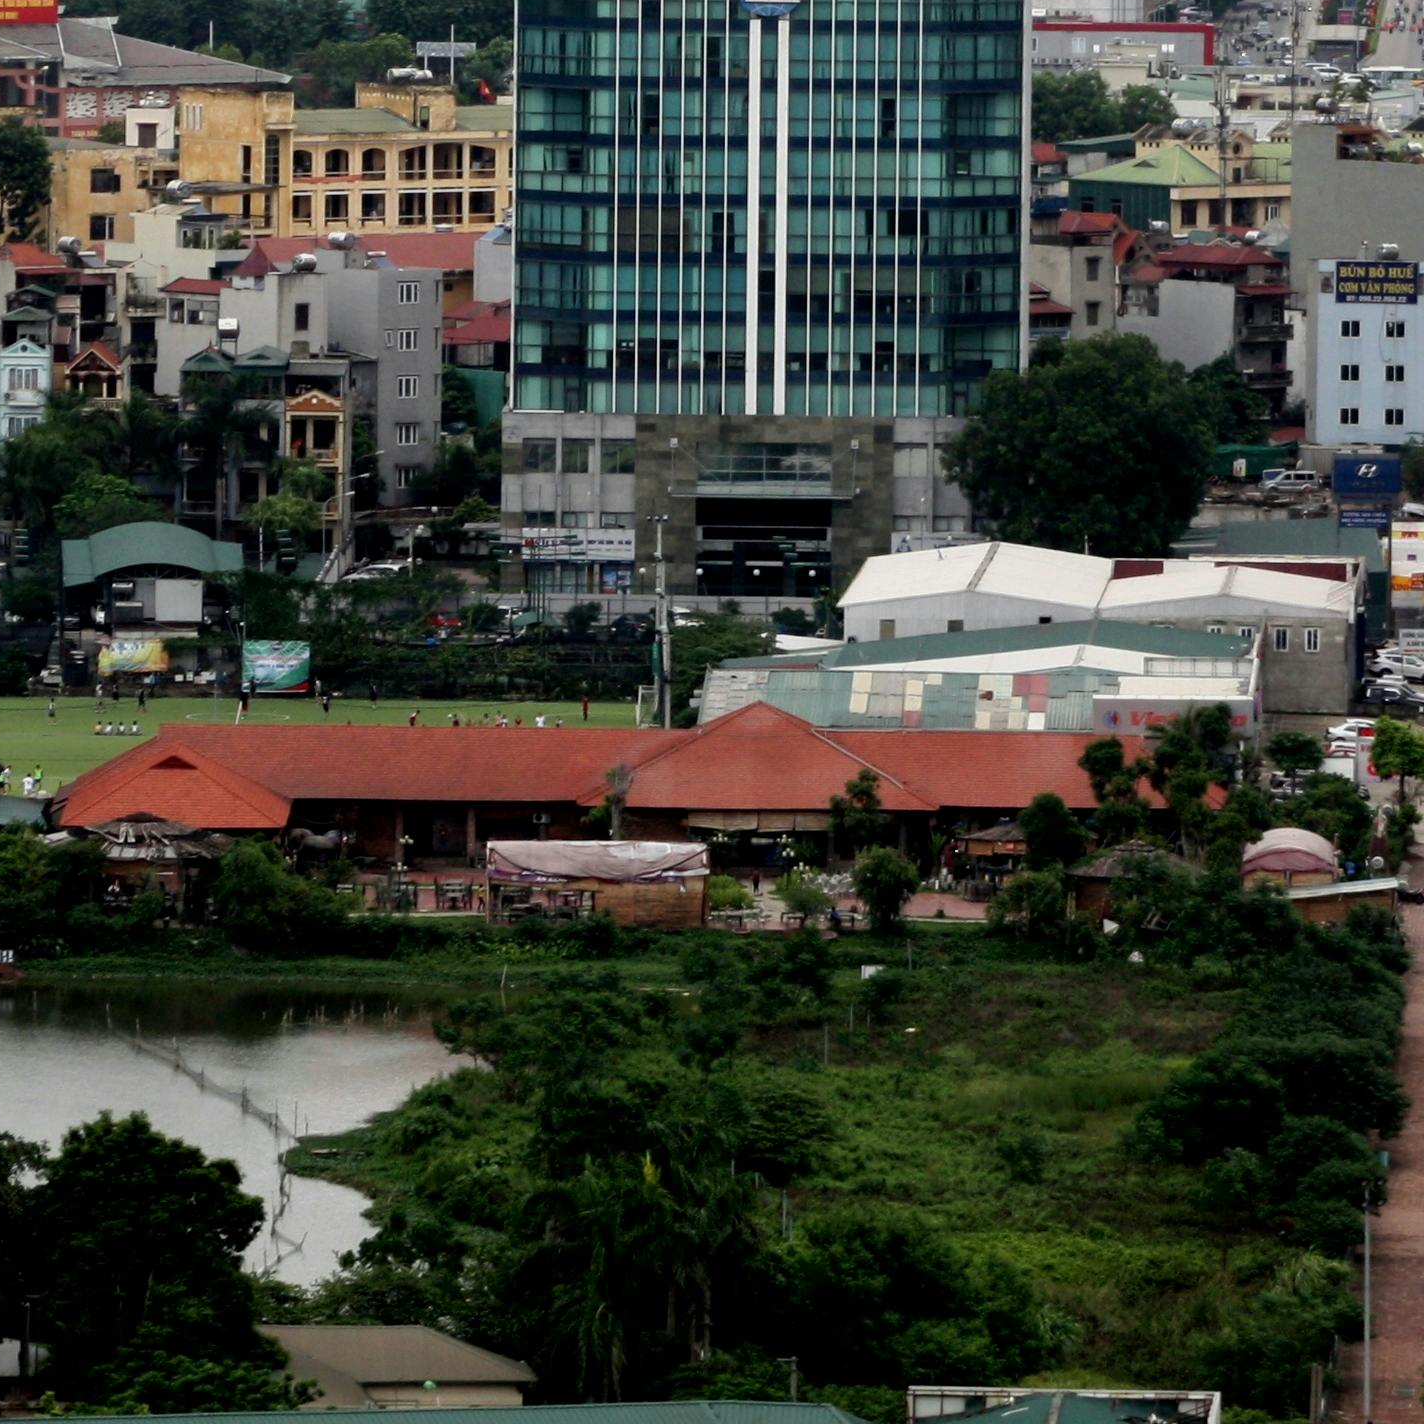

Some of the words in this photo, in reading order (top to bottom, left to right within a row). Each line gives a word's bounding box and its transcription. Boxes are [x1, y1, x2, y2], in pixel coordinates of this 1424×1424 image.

[1339, 264, 1366, 277] BÚN
[1369, 265, 1385, 277] BÒ
[1389, 264, 1415, 278] HUẾ
[1339, 282, 1358, 293] CƠM
[1383, 280, 1415, 294] PHÒNG
